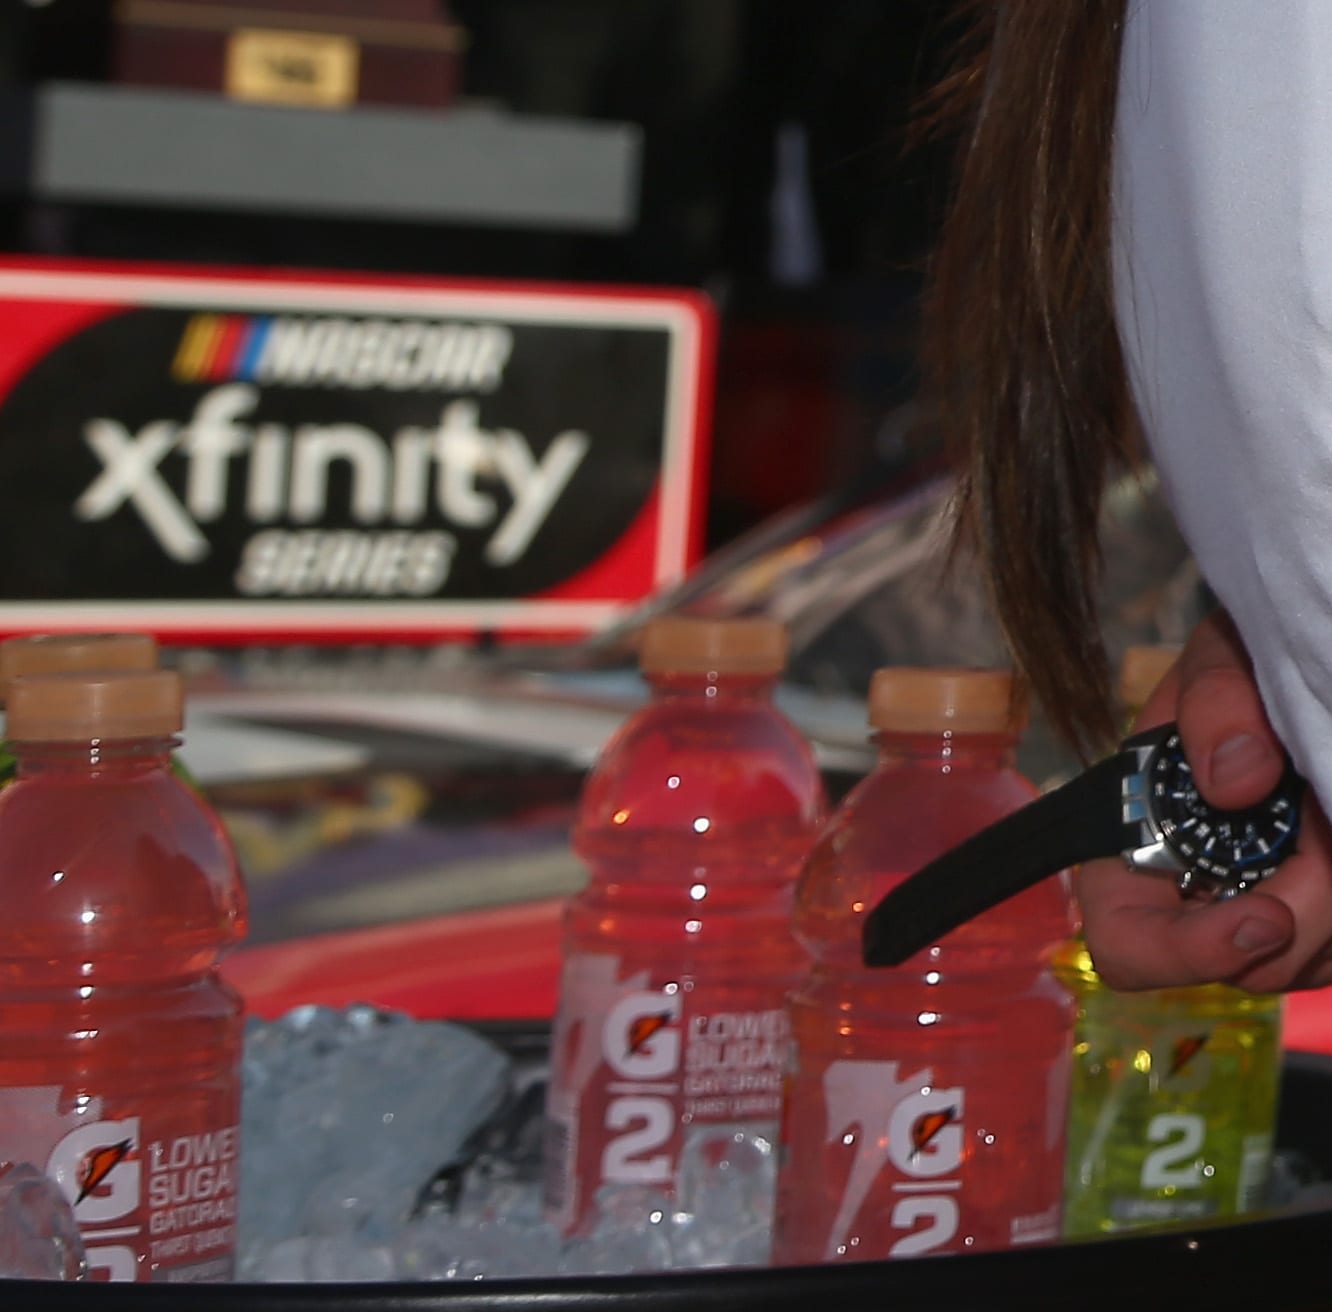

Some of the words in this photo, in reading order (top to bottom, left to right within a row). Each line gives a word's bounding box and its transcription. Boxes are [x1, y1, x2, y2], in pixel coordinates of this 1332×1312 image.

[257, 315, 513, 392] NASCAR
[75, 385, 590, 565] xfinity
[234, 528, 457, 596] SERIES
[602, 989, 683, 1079] G
[46, 1116, 142, 1224] G
[150, 1126, 238, 1173] LOWE
[603, 1095, 675, 1183] 2
[887, 1087, 965, 1178] G
[1140, 1113, 1206, 1189] 2
[150, 1162, 235, 1208] SUGA
